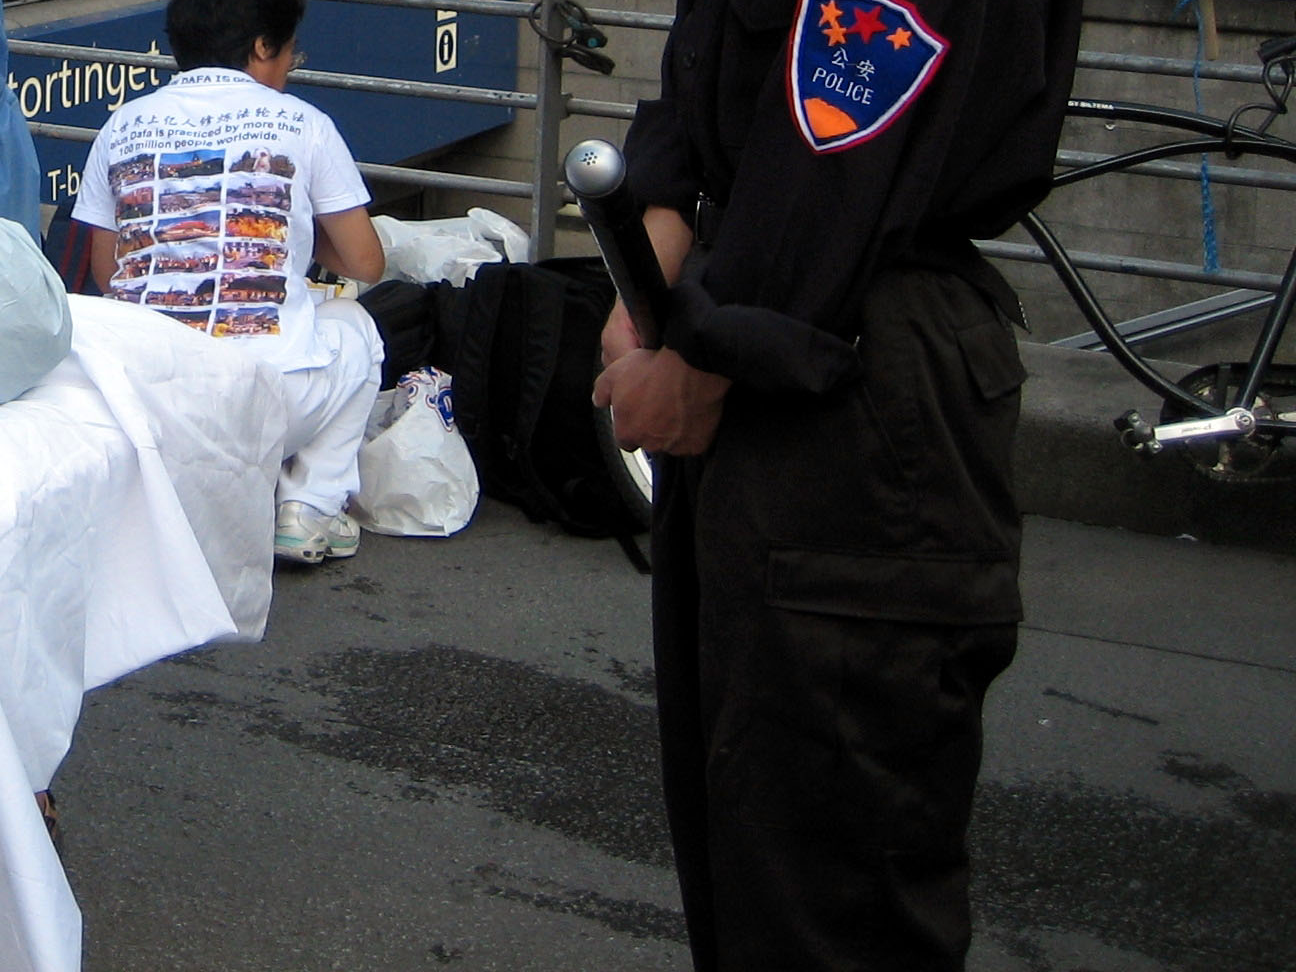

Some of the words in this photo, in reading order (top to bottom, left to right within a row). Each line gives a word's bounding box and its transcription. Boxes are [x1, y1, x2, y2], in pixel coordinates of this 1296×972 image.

[8, 39, 160, 118] tortinget
[831, 46, 876, 83] 公安
[812, 66, 874, 105] POLICE
[119, 143, 135, 157] 100
[135, 138, 173, 151] million
[174, 136, 214, 150] people
[130, 128, 152, 141] Dafa
[155, 127, 164, 138] is
[167, 125, 222, 139] practiced
[224, 122, 240, 134] by
[243, 119, 275, 130] more
[277, 121, 302, 135] than
[47, 164, 82, 202] T-b
